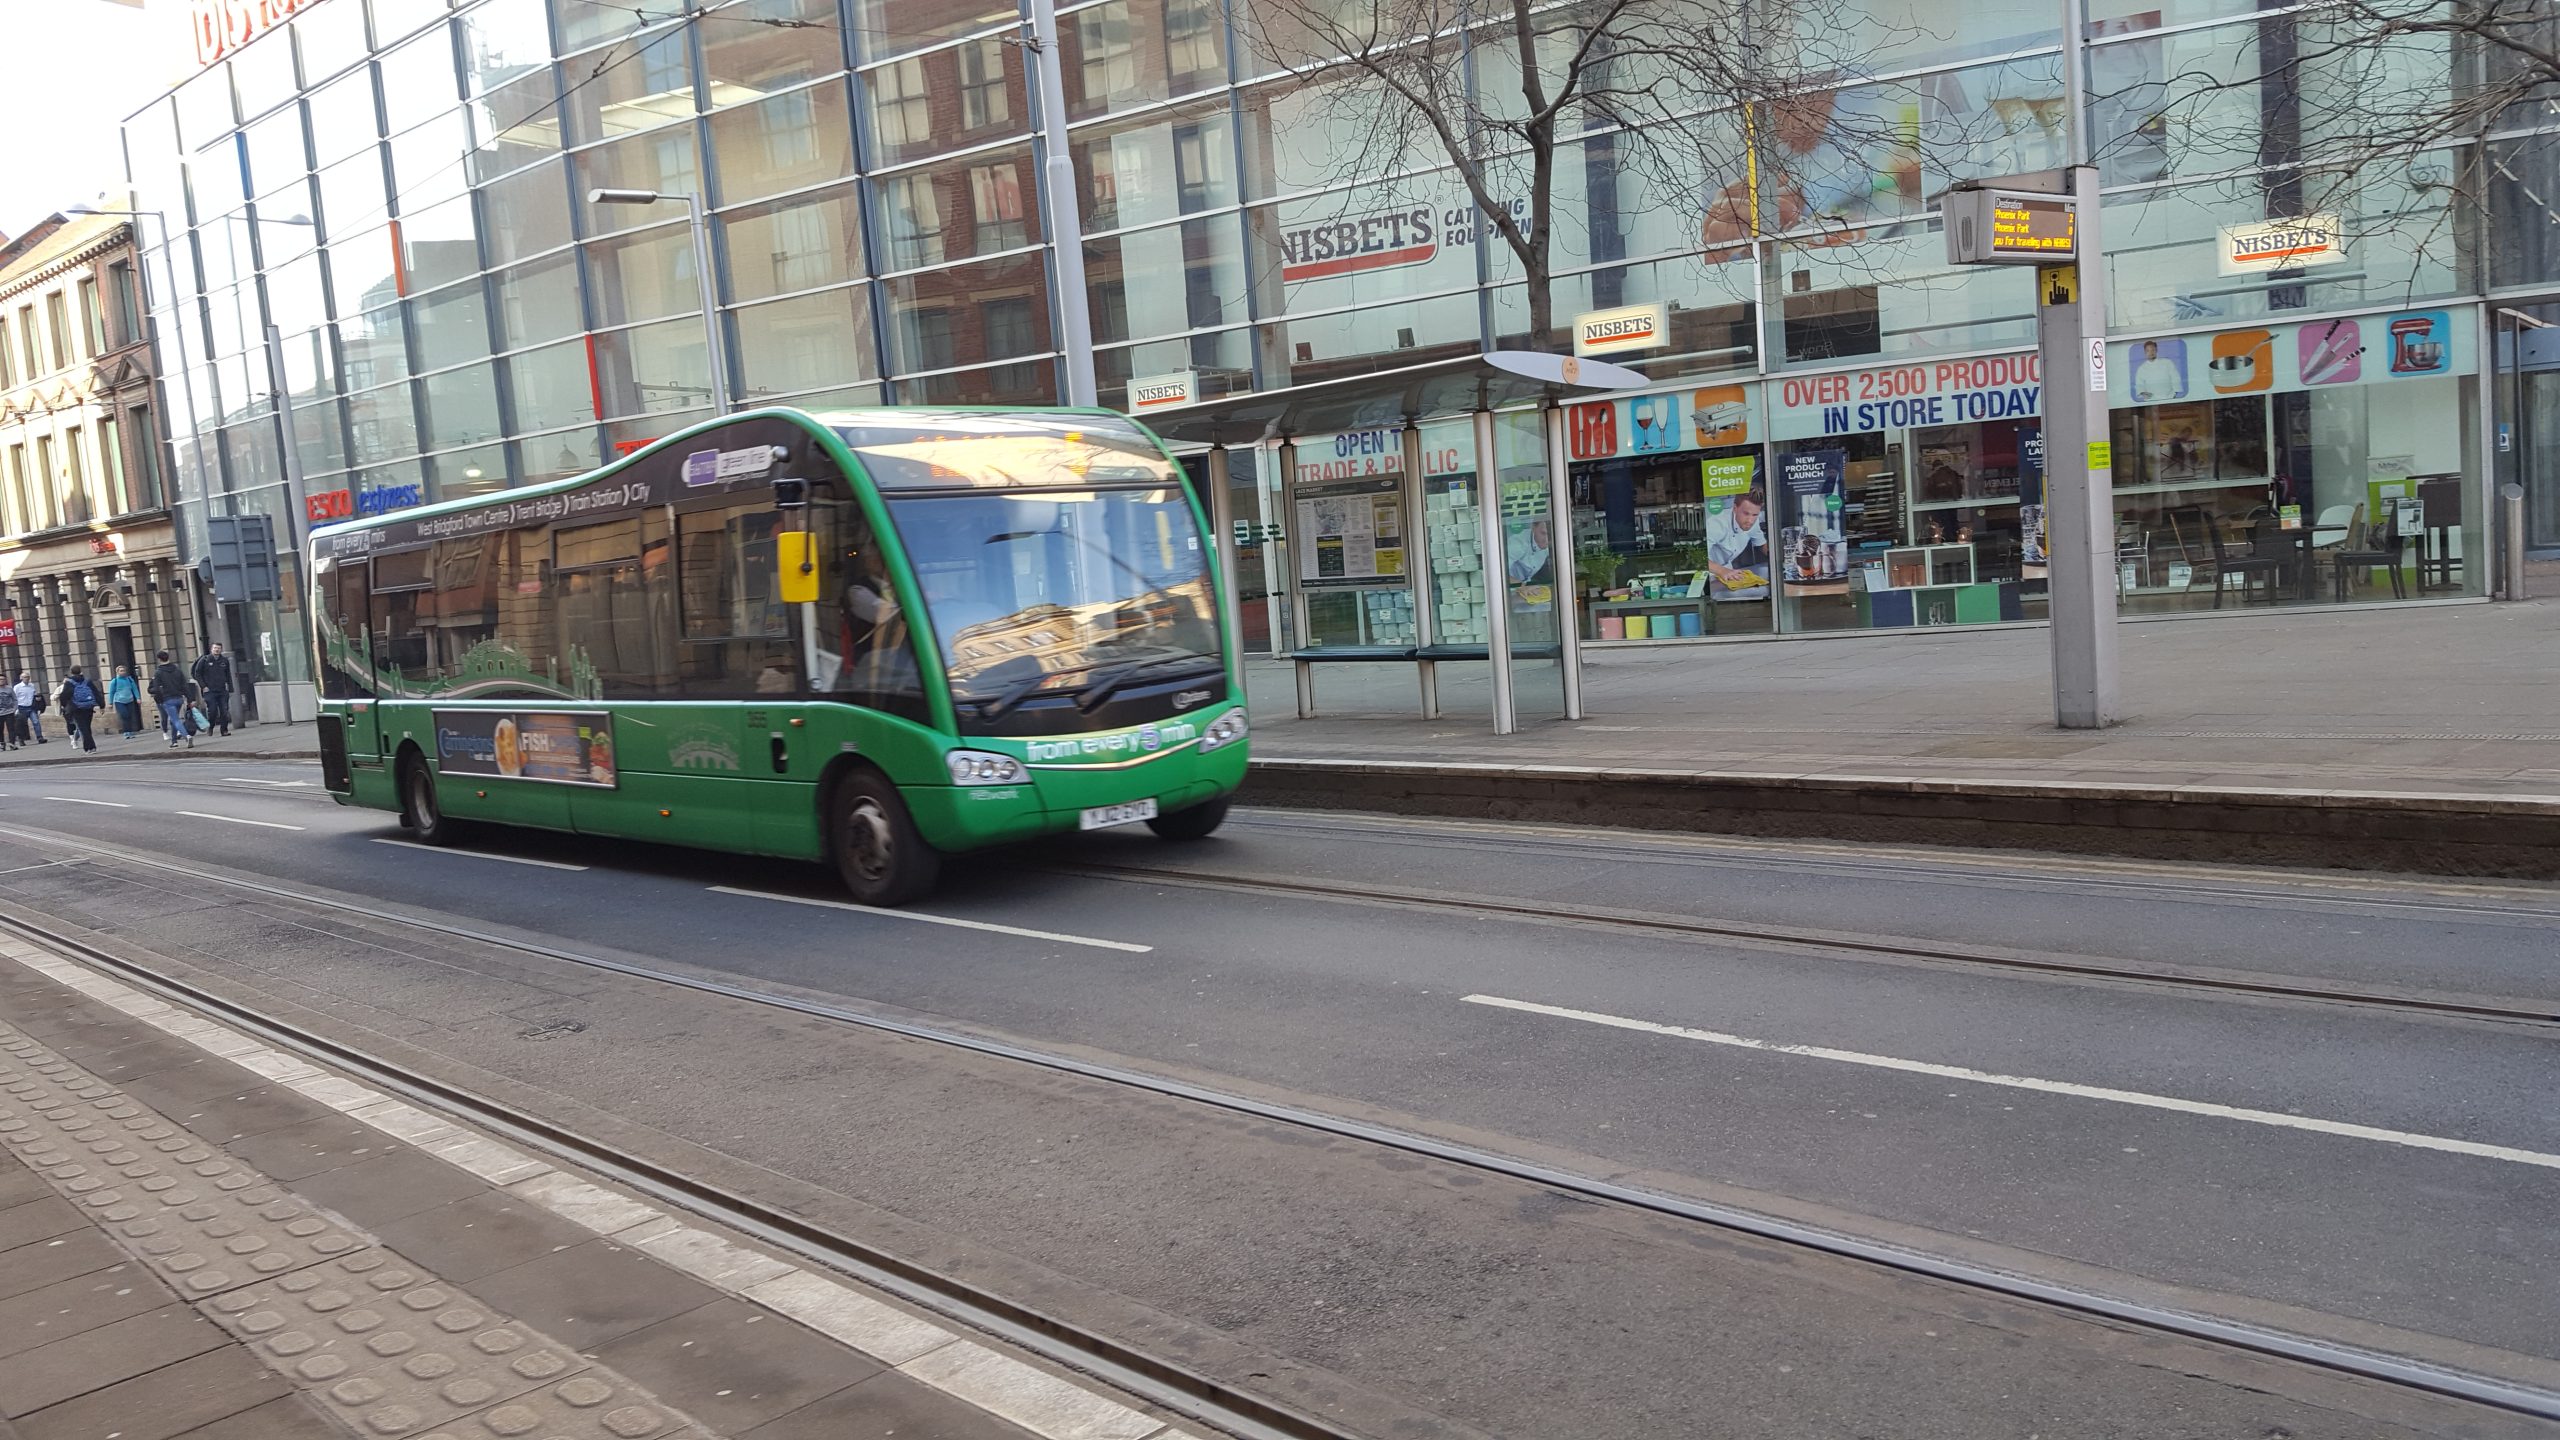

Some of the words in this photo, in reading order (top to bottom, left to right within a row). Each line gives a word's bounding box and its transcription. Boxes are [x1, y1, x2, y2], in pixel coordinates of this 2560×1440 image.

[1996, 198, 2023, 209] Destination
[1995, 209, 2016, 219] Phoenix
[2017, 210, 2030, 220] Park
[1281, 208, 1432, 265] NISBETS
[1994, 222, 2015, 232] Phoenix
[2017, 223, 2029, 233] Park
[2235, 228, 2327, 254] NISBETS
[1586, 316, 1652, 338] NISBETS
[1783, 375, 1850, 408] OVER
[1859, 367, 1927, 401] 2,500
[1936, 354, 2040, 392] PRODUC
[1137, 384, 1185, 401] NISBETS
[1824, 405, 1849, 434] IN
[1858, 396, 1944, 431] STORE
[1952, 386, 2040, 421] TODAY
[1336, 430, 1384, 458] OPEN
[1390, 428, 1404, 451] T
[1785, 462, 1826, 472] PRODUCT
[1795, 456, 1815, 464] NEW
[1297, 459, 1358, 482] TRADE
[1365, 458, 1378, 476] &
[1708, 465, 1745, 476] Green
[1788, 471, 1824, 480] LAUNCH
[1709, 477, 1743, 488] Clean
[306, 488, 352, 521] ESCO
[359, 484, 418, 515] express
[417, 522, 433, 536] West
[434, 517, 463, 537] Bridgford
[464, 513, 483, 529] Town
[483, 508, 510, 526] Centre
[516, 505, 535, 521] Trent
[536, 500, 562, 518] Bridge
[570, 495, 590, 512] Train
[591, 490, 622, 508] Station
[631, 483, 651, 503] City
[332, 535, 346, 550] from
[520, 733, 549, 752] FISH
[1027, 739, 1079, 762] from
[1082, 732, 1139, 753] every
[1140, 723, 1161, 750] 5
[1162, 721, 1195, 743] min
